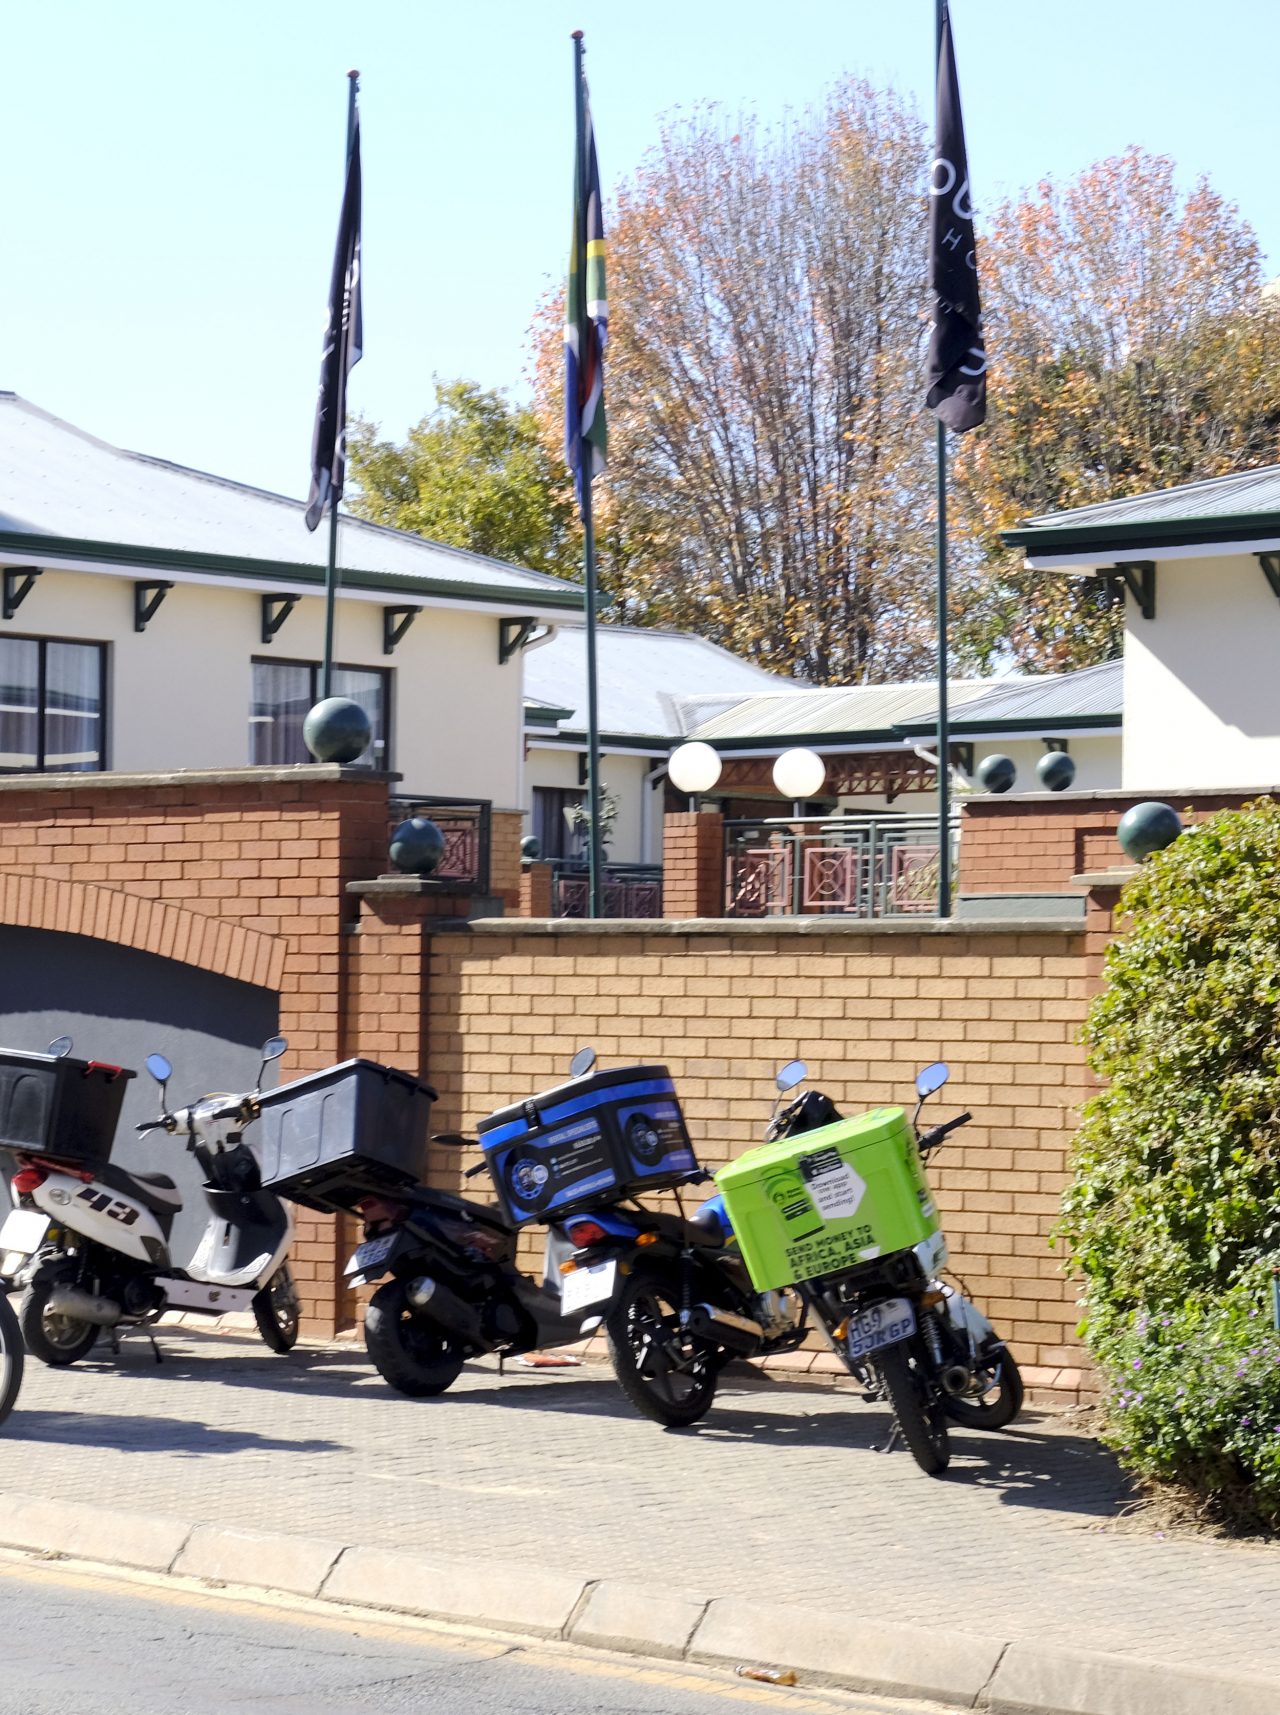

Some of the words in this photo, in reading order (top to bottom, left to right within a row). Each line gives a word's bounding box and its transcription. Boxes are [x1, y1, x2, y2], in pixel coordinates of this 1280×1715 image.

[785, 1242, 814, 1257] SEND
[815, 1229, 854, 1248] MONEY
[856, 1224, 872, 1236] TO
[844, 1234, 876, 1252] ASIA
[793, 1269, 803, 1280] &
[805, 1252, 858, 1277] EUROPE
[889, 1318, 912, 1339] GP
